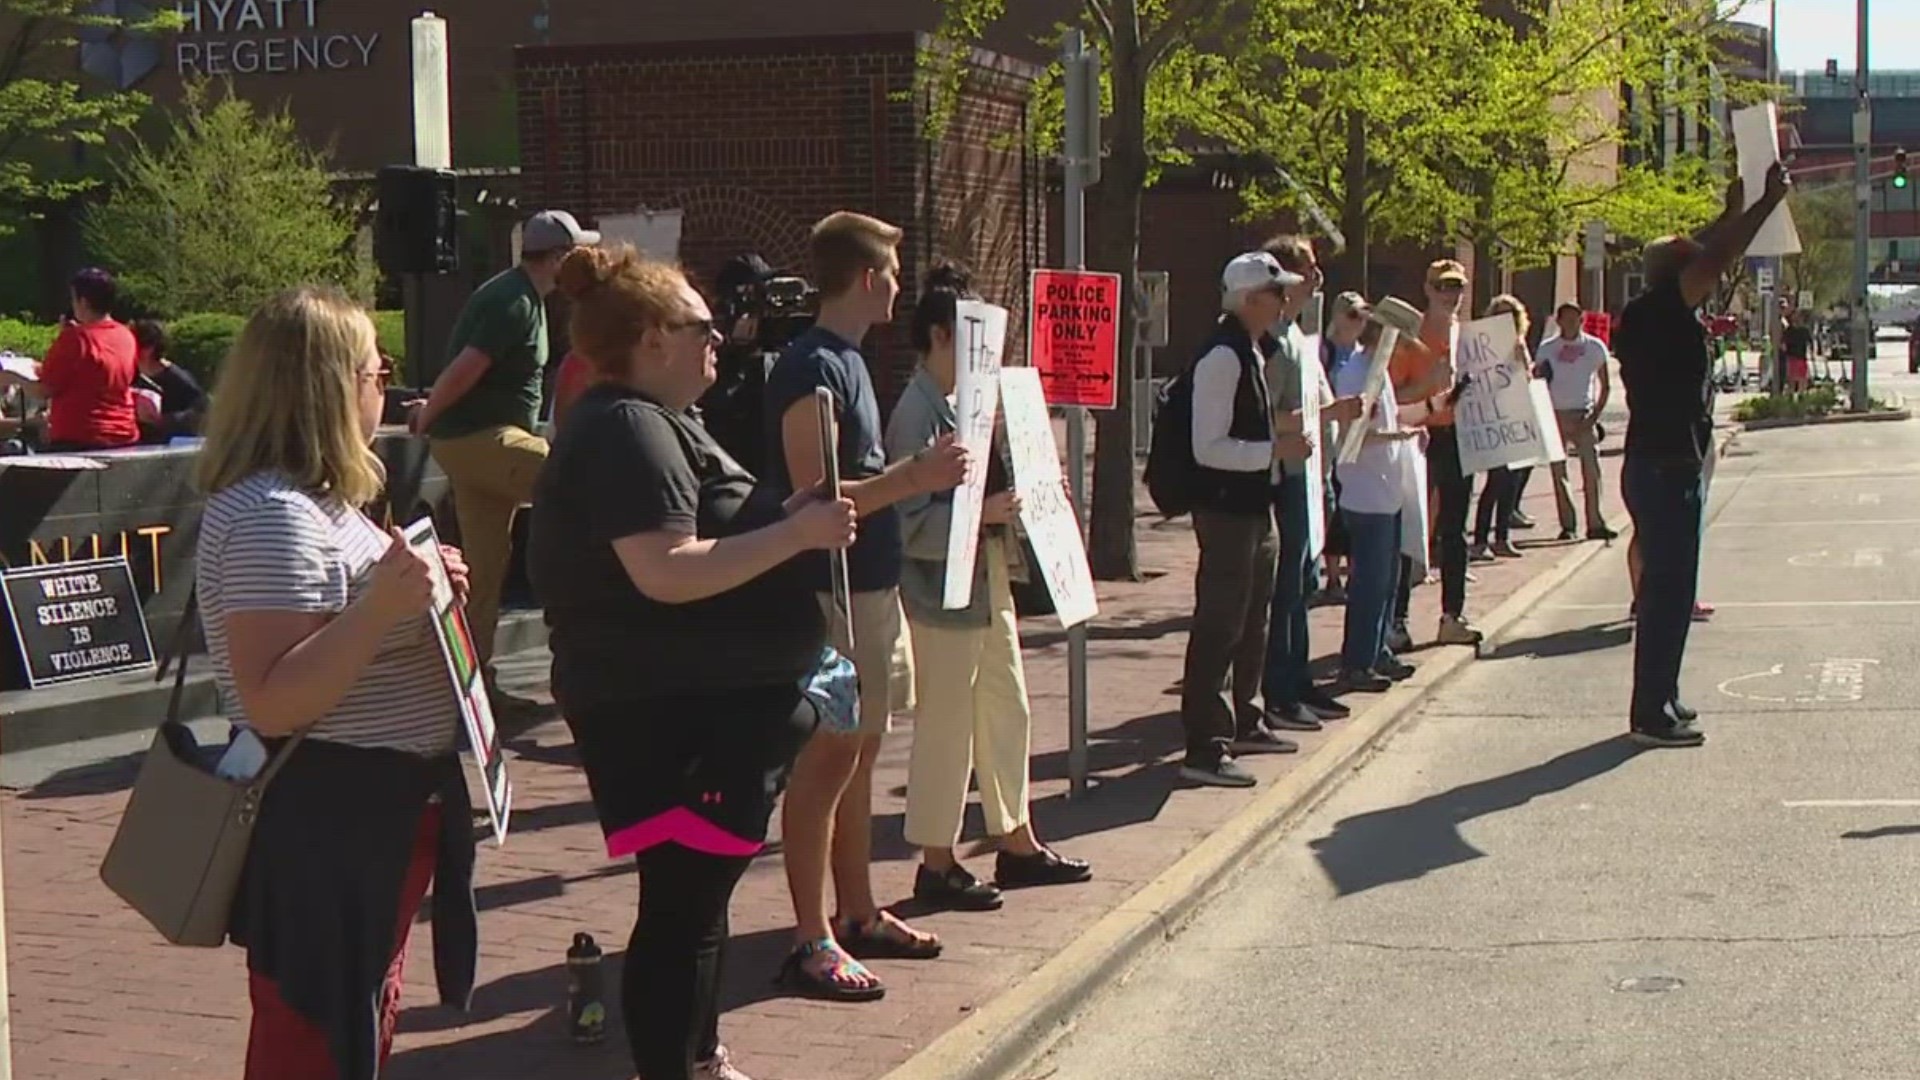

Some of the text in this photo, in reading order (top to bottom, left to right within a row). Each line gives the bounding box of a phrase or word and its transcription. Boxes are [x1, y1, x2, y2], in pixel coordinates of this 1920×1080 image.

[176, 33, 379, 75] REGENCY
[1046, 284, 1105, 303] POLICE
[1038, 303, 1111, 323] PARKING
[1052, 322, 1097, 341] ONLY
[39, 573, 102, 599] WHITE
[37, 597, 118, 626] SILENCE
[70, 626, 92, 644] IS
[50, 643, 132, 671] VIOLENCE
